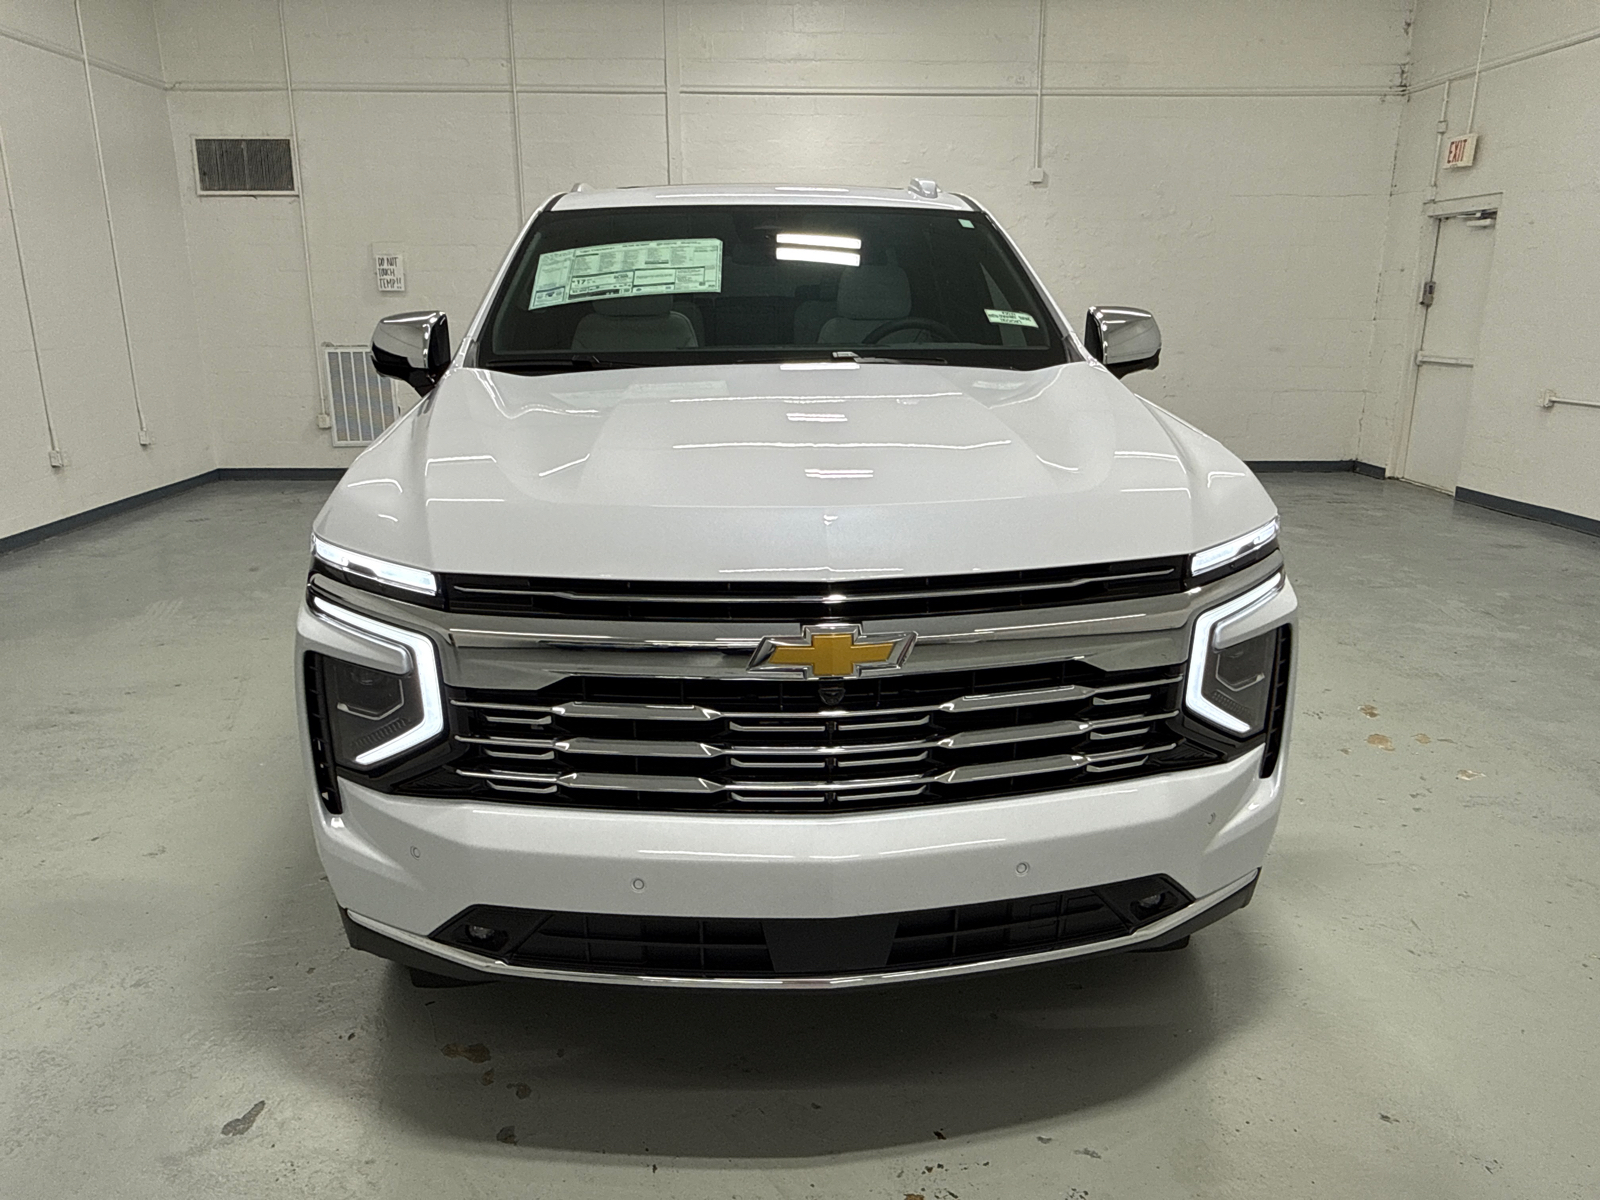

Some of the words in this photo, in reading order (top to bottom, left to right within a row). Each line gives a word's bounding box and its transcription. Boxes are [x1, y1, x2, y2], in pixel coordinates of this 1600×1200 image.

[1447, 139, 1467, 164] EXIT
[377, 257, 385, 267] DO
[386, 256, 399, 267] NOT
[378, 268, 396, 277] TOUCH
[379, 277, 402, 289] TEMP!!
